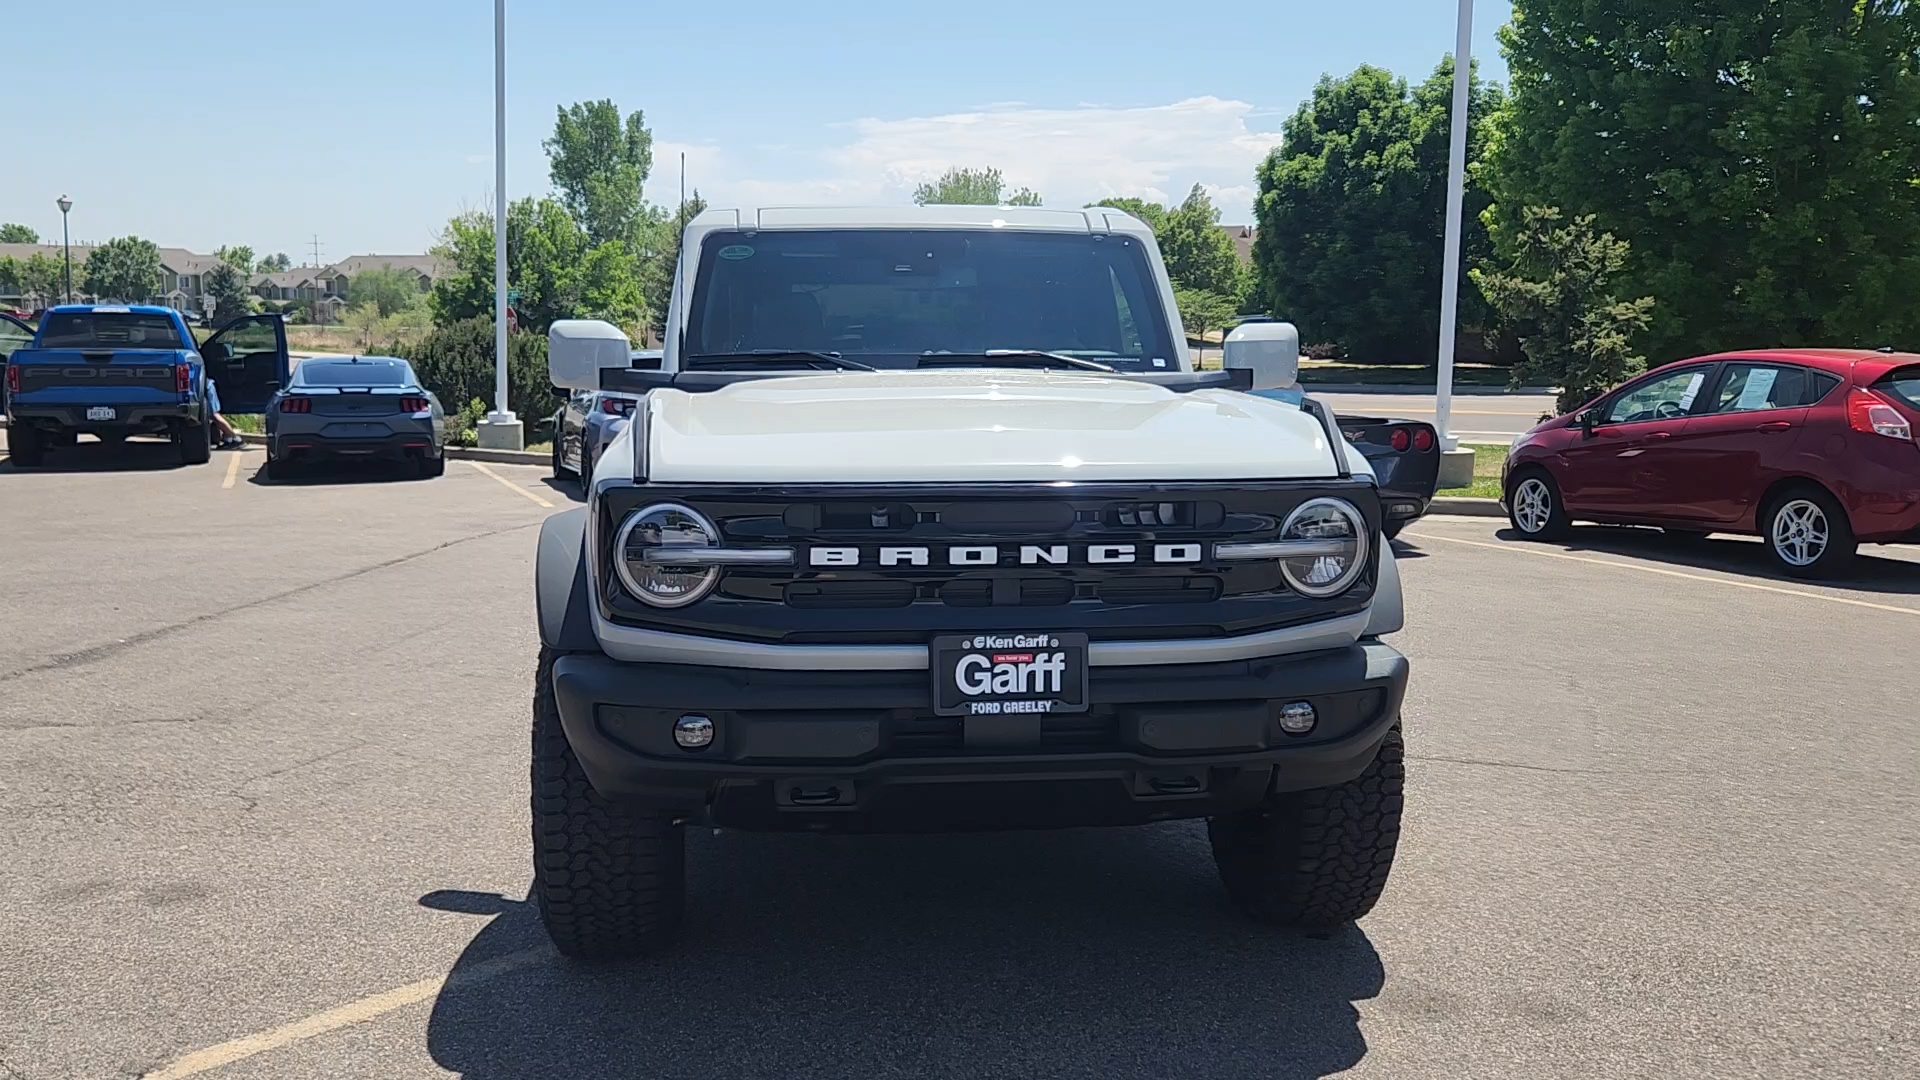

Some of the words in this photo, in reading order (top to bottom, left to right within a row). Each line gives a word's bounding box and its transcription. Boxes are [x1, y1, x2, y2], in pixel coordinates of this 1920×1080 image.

[24, 367, 171, 378] FORD
[809, 544, 1201, 566] BRONCO
[986, 635, 1013, 649] Ken
[1014, 634, 1049, 648] Garff
[955, 652, 1066, 695] Garff
[971, 702, 1001, 715] FORD
[1003, 700, 1052, 714] GREELEY
